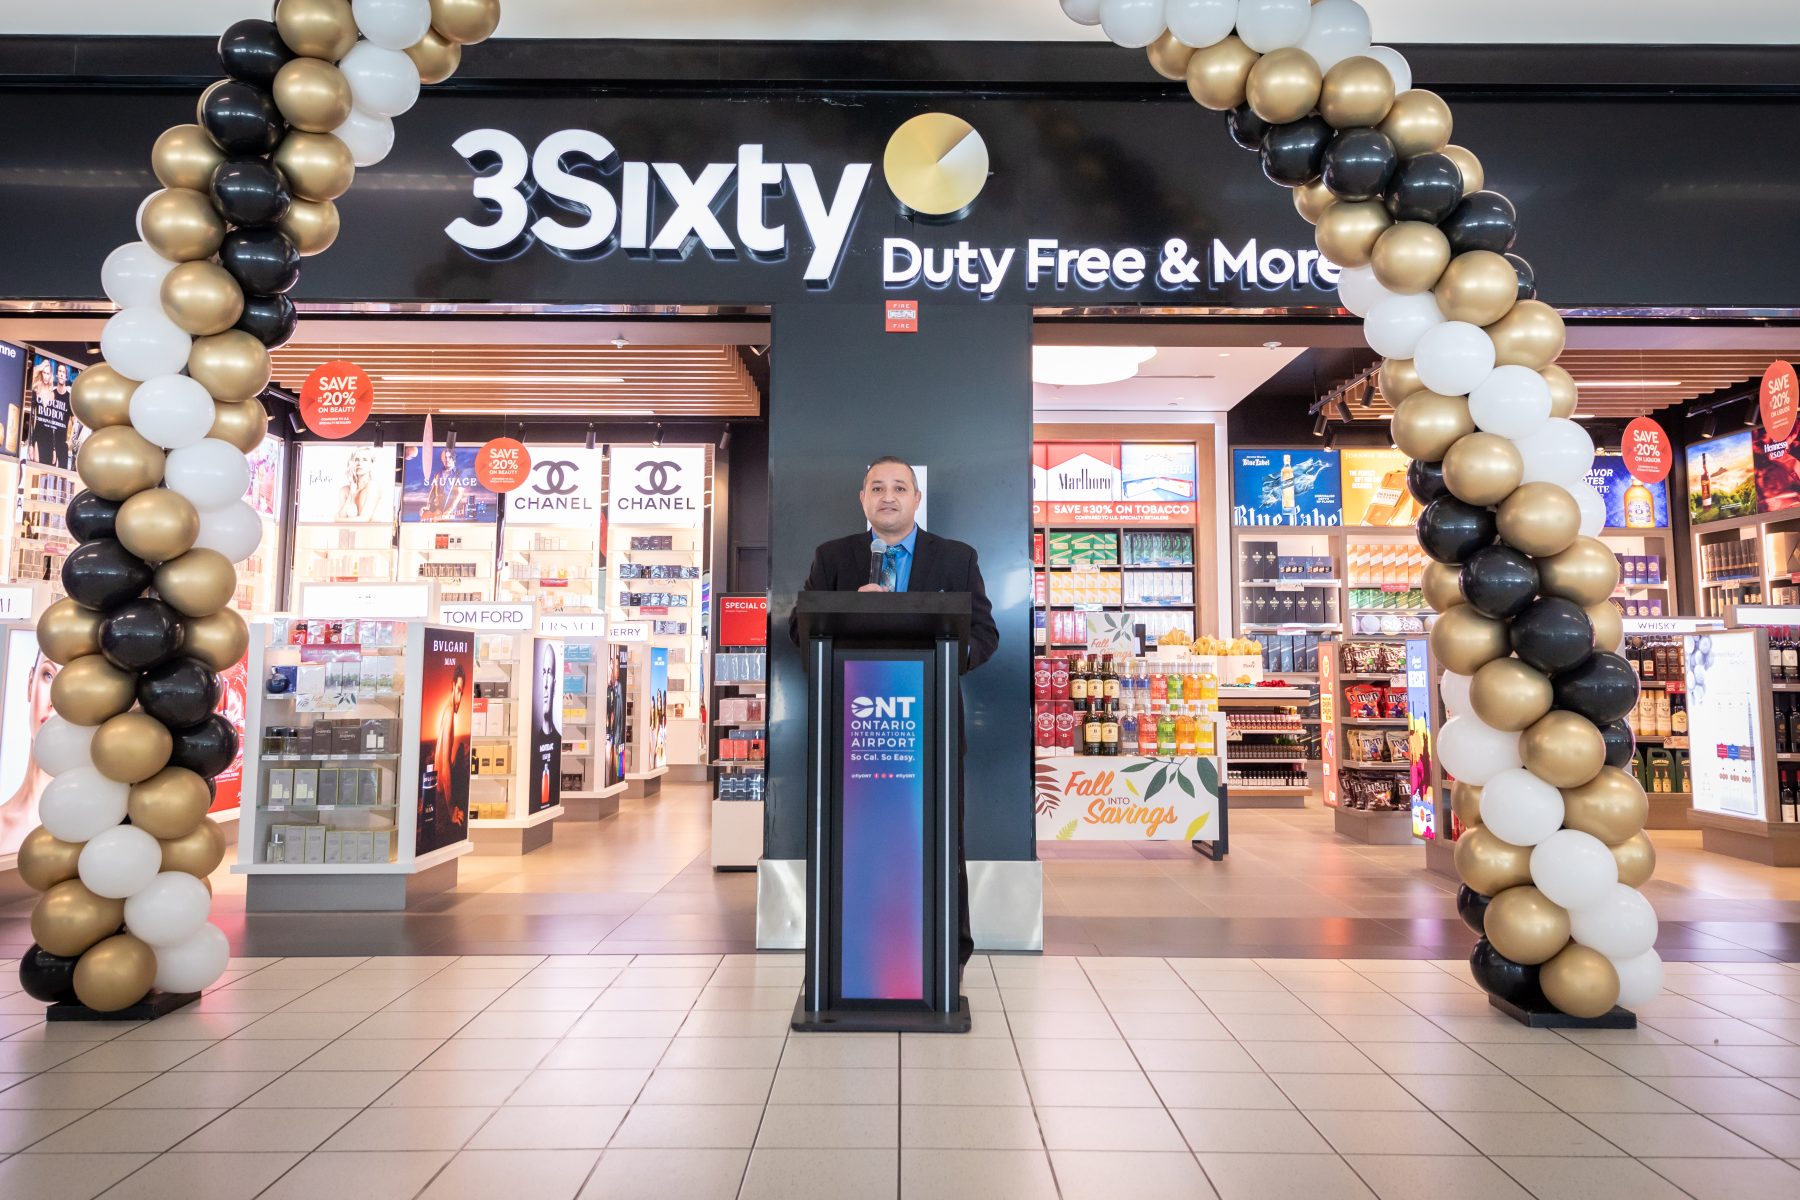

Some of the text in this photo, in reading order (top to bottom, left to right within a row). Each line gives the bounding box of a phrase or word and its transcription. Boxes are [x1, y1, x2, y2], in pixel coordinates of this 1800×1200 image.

[445, 127, 872, 281] 3Sixty
[883, 238, 1343, 294] Duty Free & More
[318, 376, 358, 391] SAVE
[1768, 373, 1791, 395] SAVE
[322, 391, 357, 406] 20%
[1771, 390, 1791, 411] 20%
[51, 408, 65, 421] BOY
[318, 406, 356, 414] ON BEAUTY
[1633, 429, 1659, 444] SAVE
[489, 447, 520, 459] SAVE
[1636, 443, 1661, 456] 20%
[492, 459, 519, 470] 20%
[423, 476, 478, 488] SAUVAGE
[1058, 468, 1112, 491] Marlboro
[514, 496, 593, 511] CHANEL
[617, 496, 696, 511] CHANEL
[1054, 504, 1081, 514] SAVE
[1090, 504, 1113, 514] 30%
[1115, 504, 1133, 514] ON
[1135, 504, 1190, 514] TOBACCO
[725, 601, 758, 609] SPECIAL
[443, 610, 524, 624] TOM FORD
[1637, 622, 1677, 630] WHISKY
[433, 640, 468, 654] BVLGARI
[444, 657, 456, 666] MAN
[850, 696, 916, 718] ONT
[851, 720, 916, 730] ONTARIO
[851, 738, 916, 748] AIRPORT
[850, 753, 916, 763] So Cal. So Easy.
[1064, 769, 1116, 796] Fall
[1107, 797, 1130, 805] INTO
[1082, 797, 1179, 838] Savings
